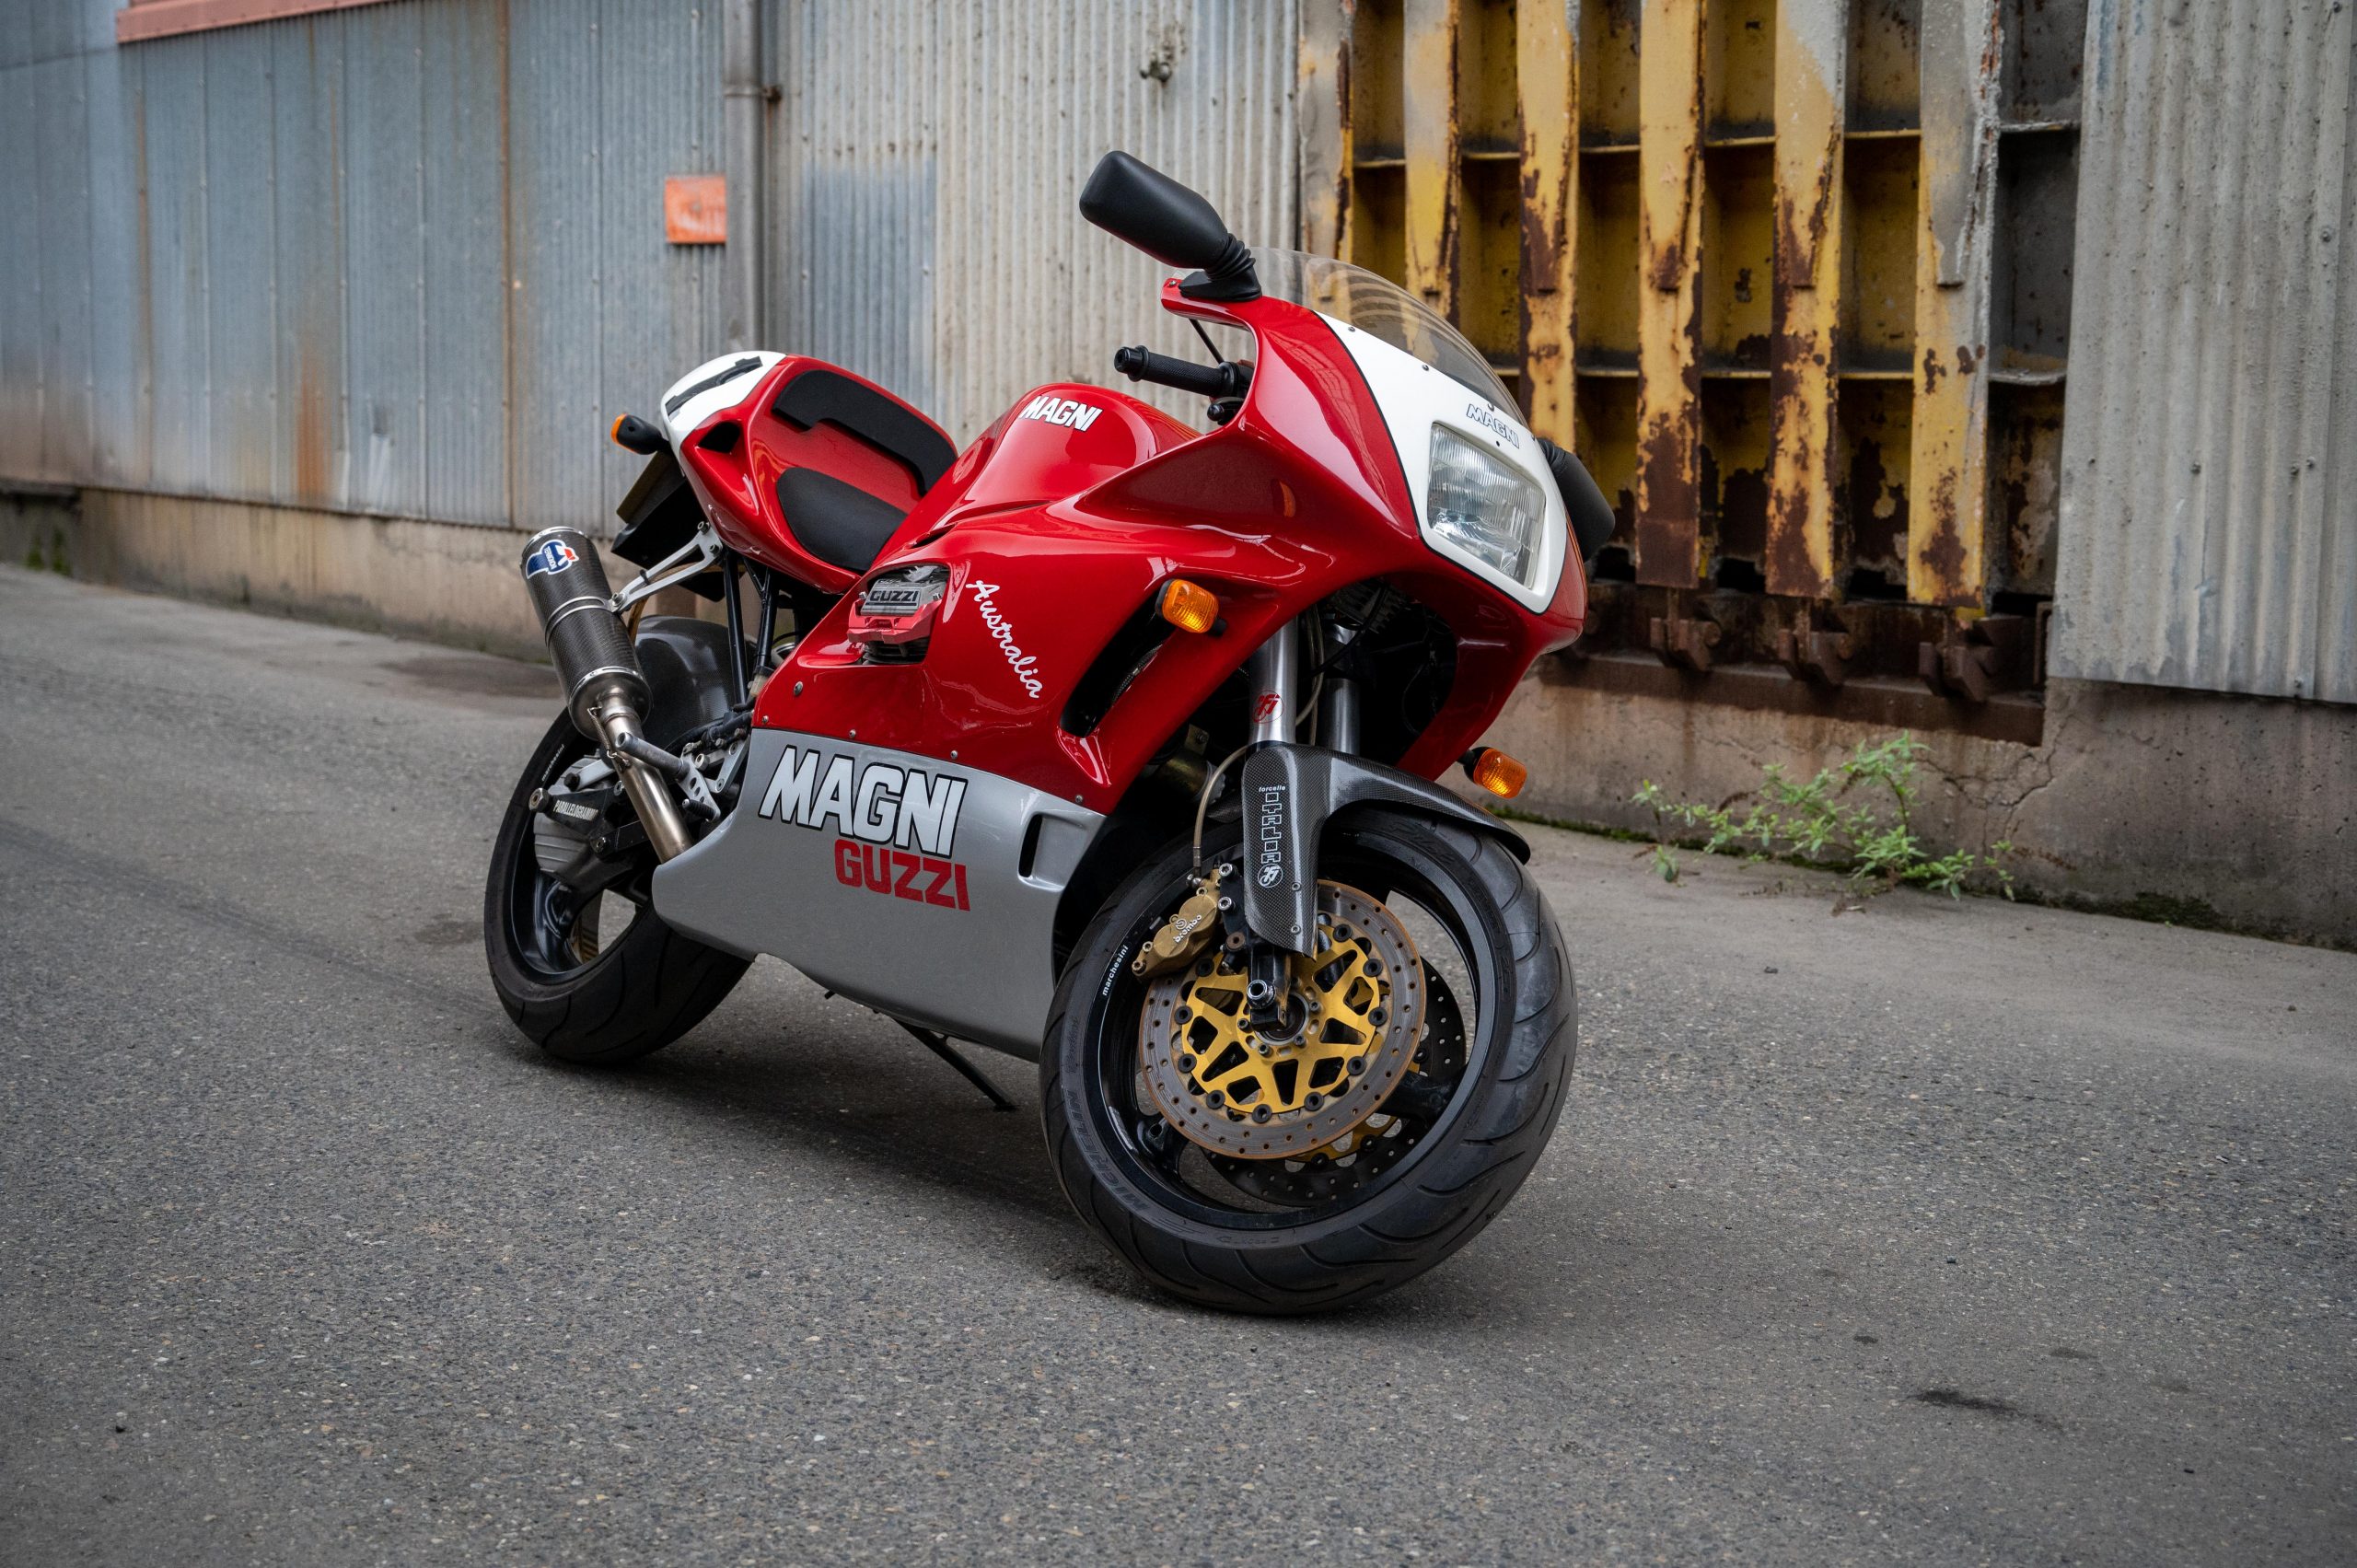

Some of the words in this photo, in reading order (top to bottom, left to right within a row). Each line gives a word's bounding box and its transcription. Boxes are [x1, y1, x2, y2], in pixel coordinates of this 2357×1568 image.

[1017, 395, 1103, 432] MAGNI
[1466, 403, 1520, 449] MAGNI
[869, 590, 920, 602] GUZZI
[966, 579, 1044, 700] Australia
[758, 744, 969, 859] MAGNI
[1260, 792, 1283, 865] ITALIA
[834, 839, 971, 912] GUZZI
[1173, 914, 1202, 943] brembo
[1102, 944, 1129, 996] marchesini
[1065, 1089, 1152, 1213] MICHELIN
